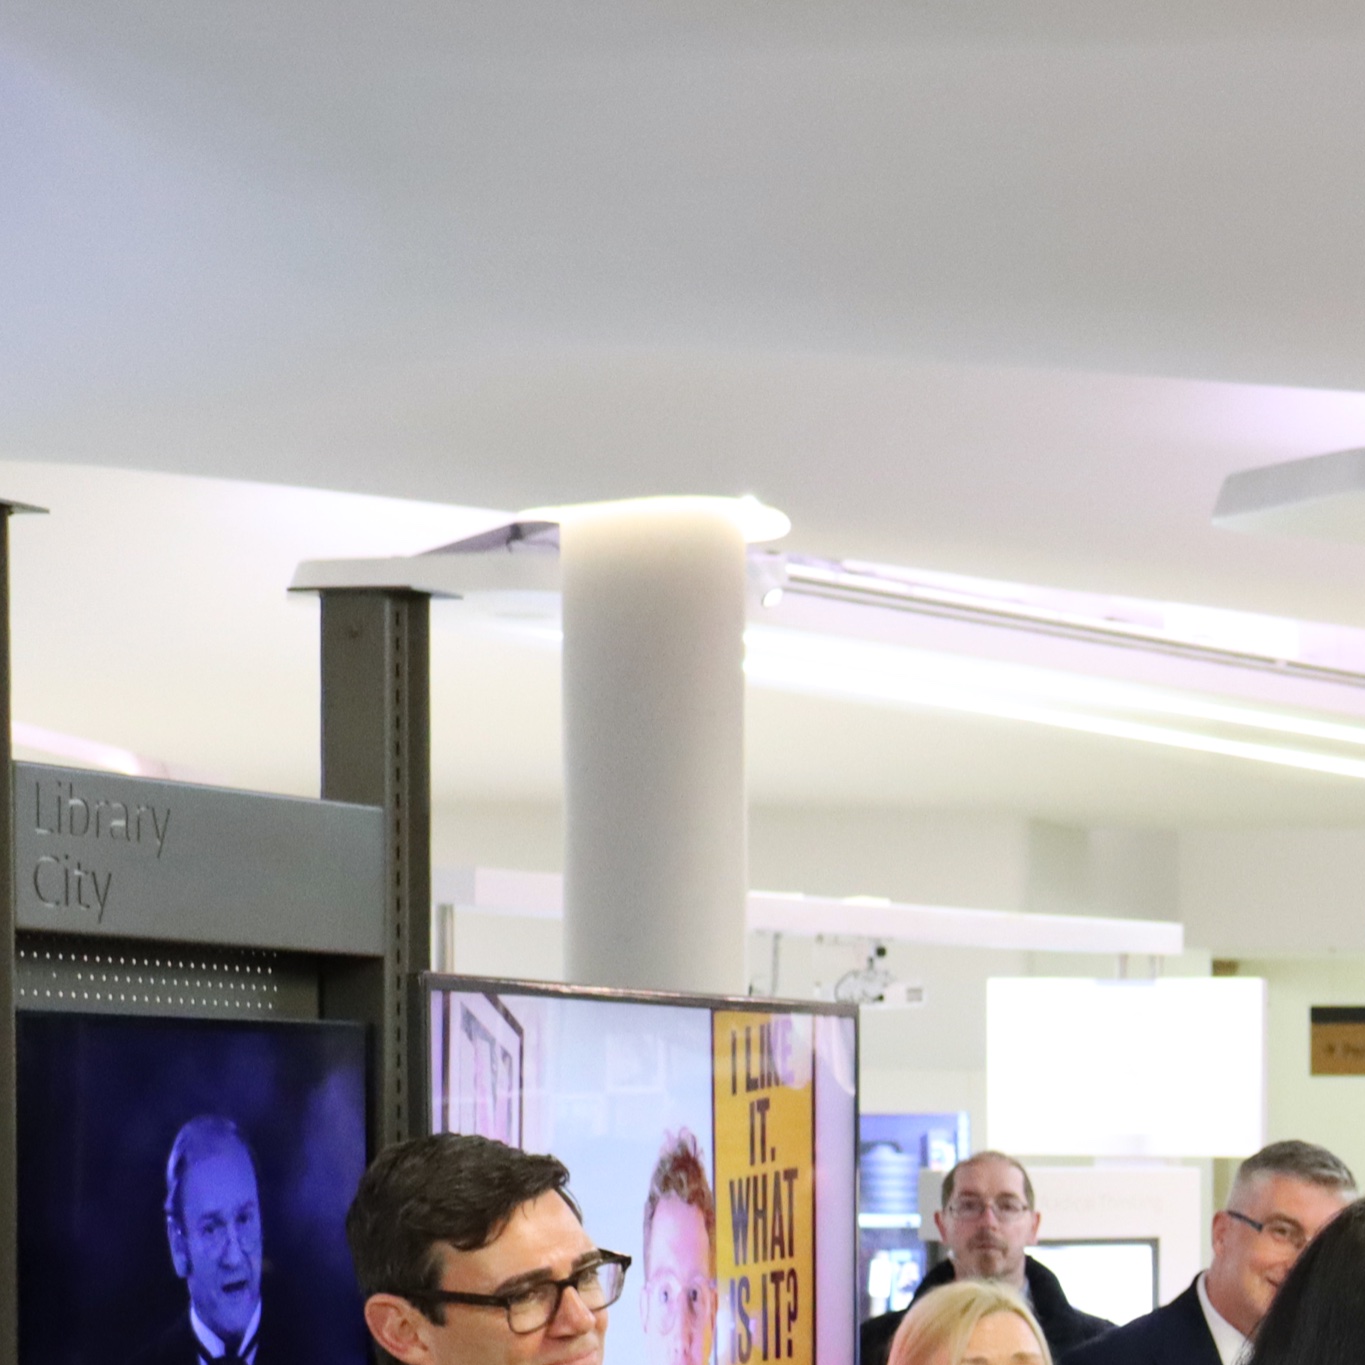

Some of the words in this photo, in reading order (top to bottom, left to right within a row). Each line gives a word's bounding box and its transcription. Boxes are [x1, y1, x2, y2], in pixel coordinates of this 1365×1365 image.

[34, 781, 171, 859] Library
[33, 854, 112, 924] City
[730, 1032, 737, 1095] I
[746, 1020, 795, 1092] LIKE
[749, 1097, 776, 1166] IT.
[729, 1169, 798, 1266] WHAT
[761, 1268, 798, 1362] IT?
